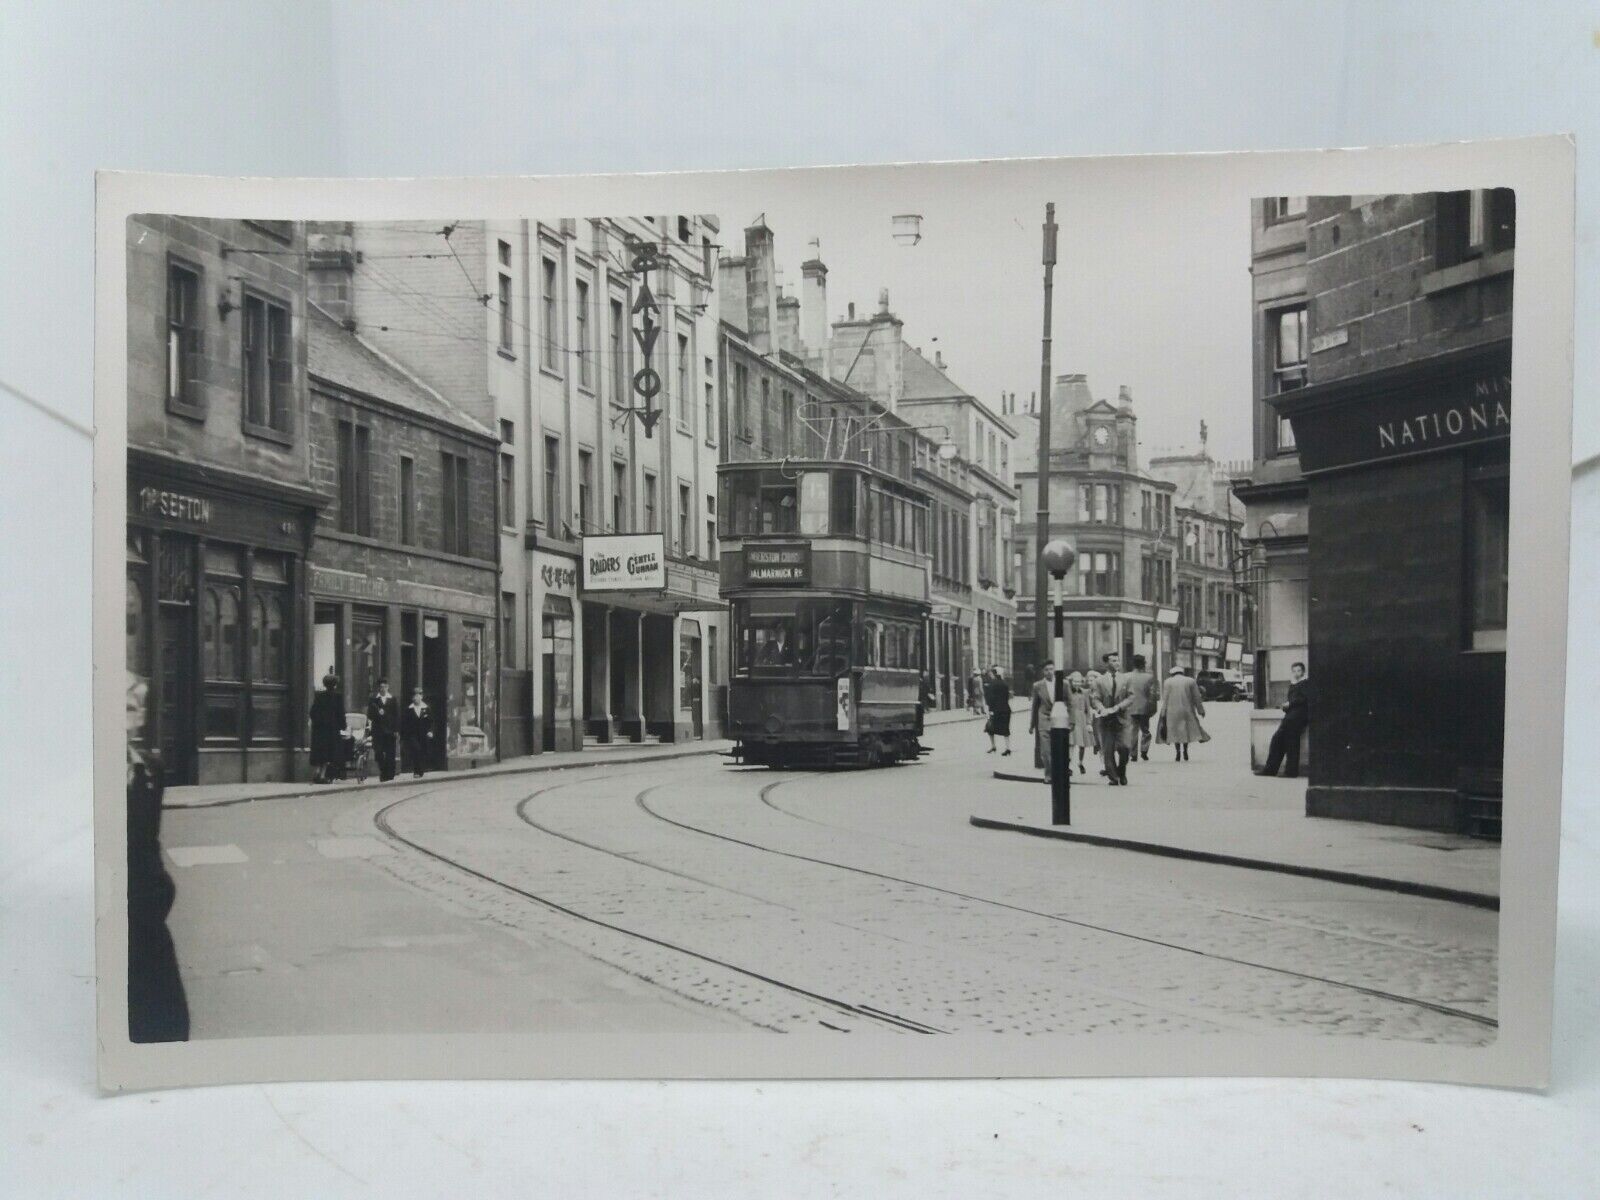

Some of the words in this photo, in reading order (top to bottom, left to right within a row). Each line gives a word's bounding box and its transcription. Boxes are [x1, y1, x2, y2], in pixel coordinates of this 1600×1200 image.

[1378, 401, 1511, 449] NATIONA
[160, 491, 210, 523] SEFTON
[589, 556, 621, 576] RAIDERS
